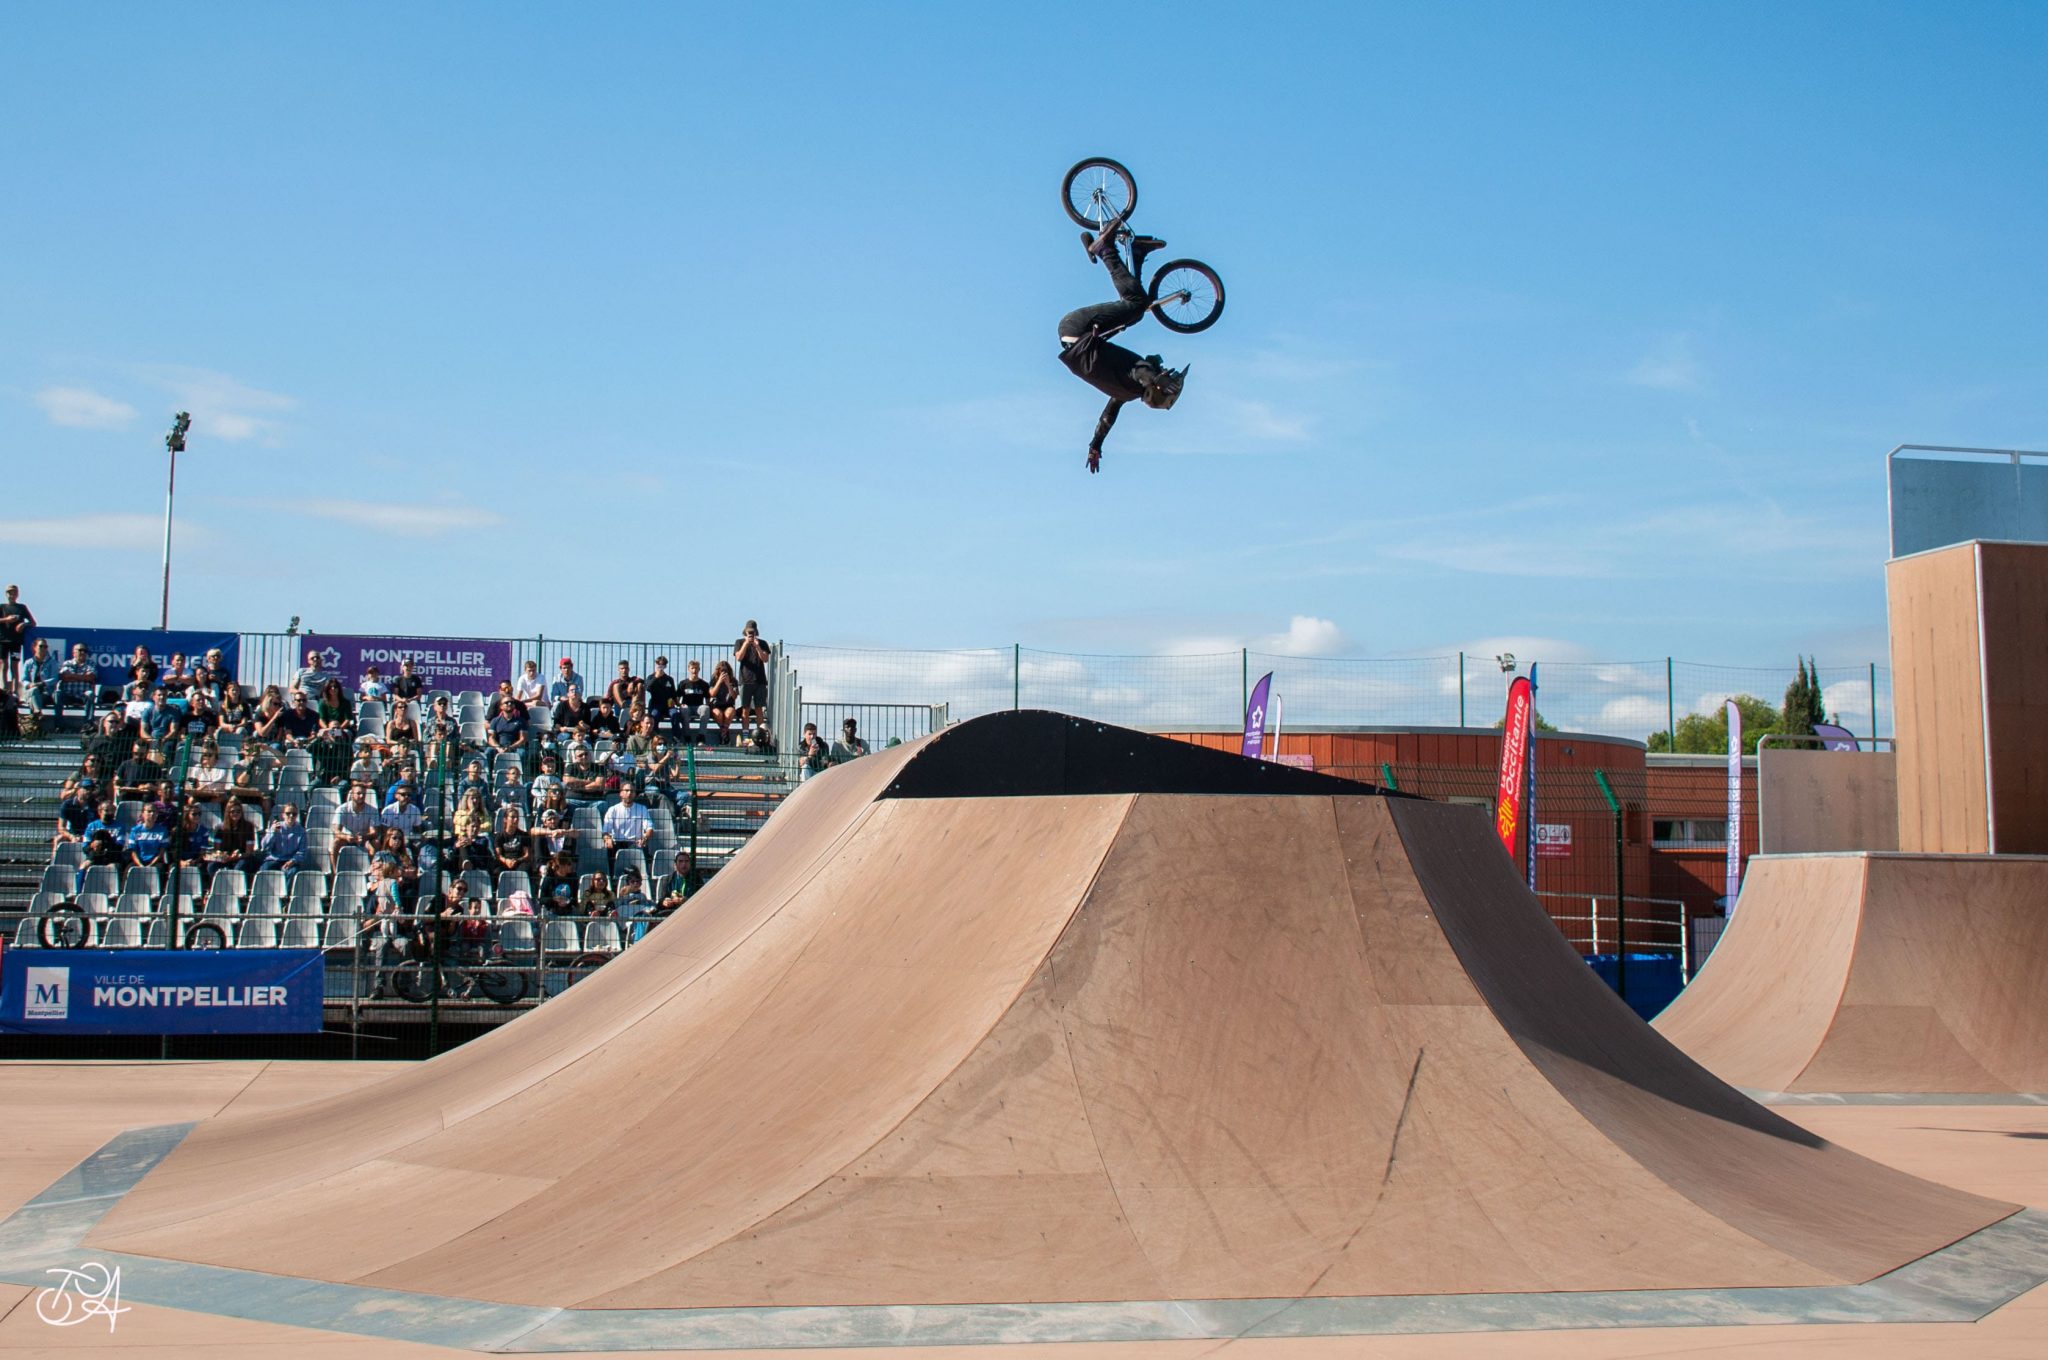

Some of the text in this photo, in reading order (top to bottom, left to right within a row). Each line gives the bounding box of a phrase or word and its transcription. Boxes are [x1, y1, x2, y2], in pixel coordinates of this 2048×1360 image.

[360, 649, 485, 665] MONTPELLIER
[1505, 695, 1524, 795] Occitanie
[94, 975, 145, 985] VILLE DE
[35, 983, 60, 1005] M
[94, 986, 288, 1007] MONTPELLIER
